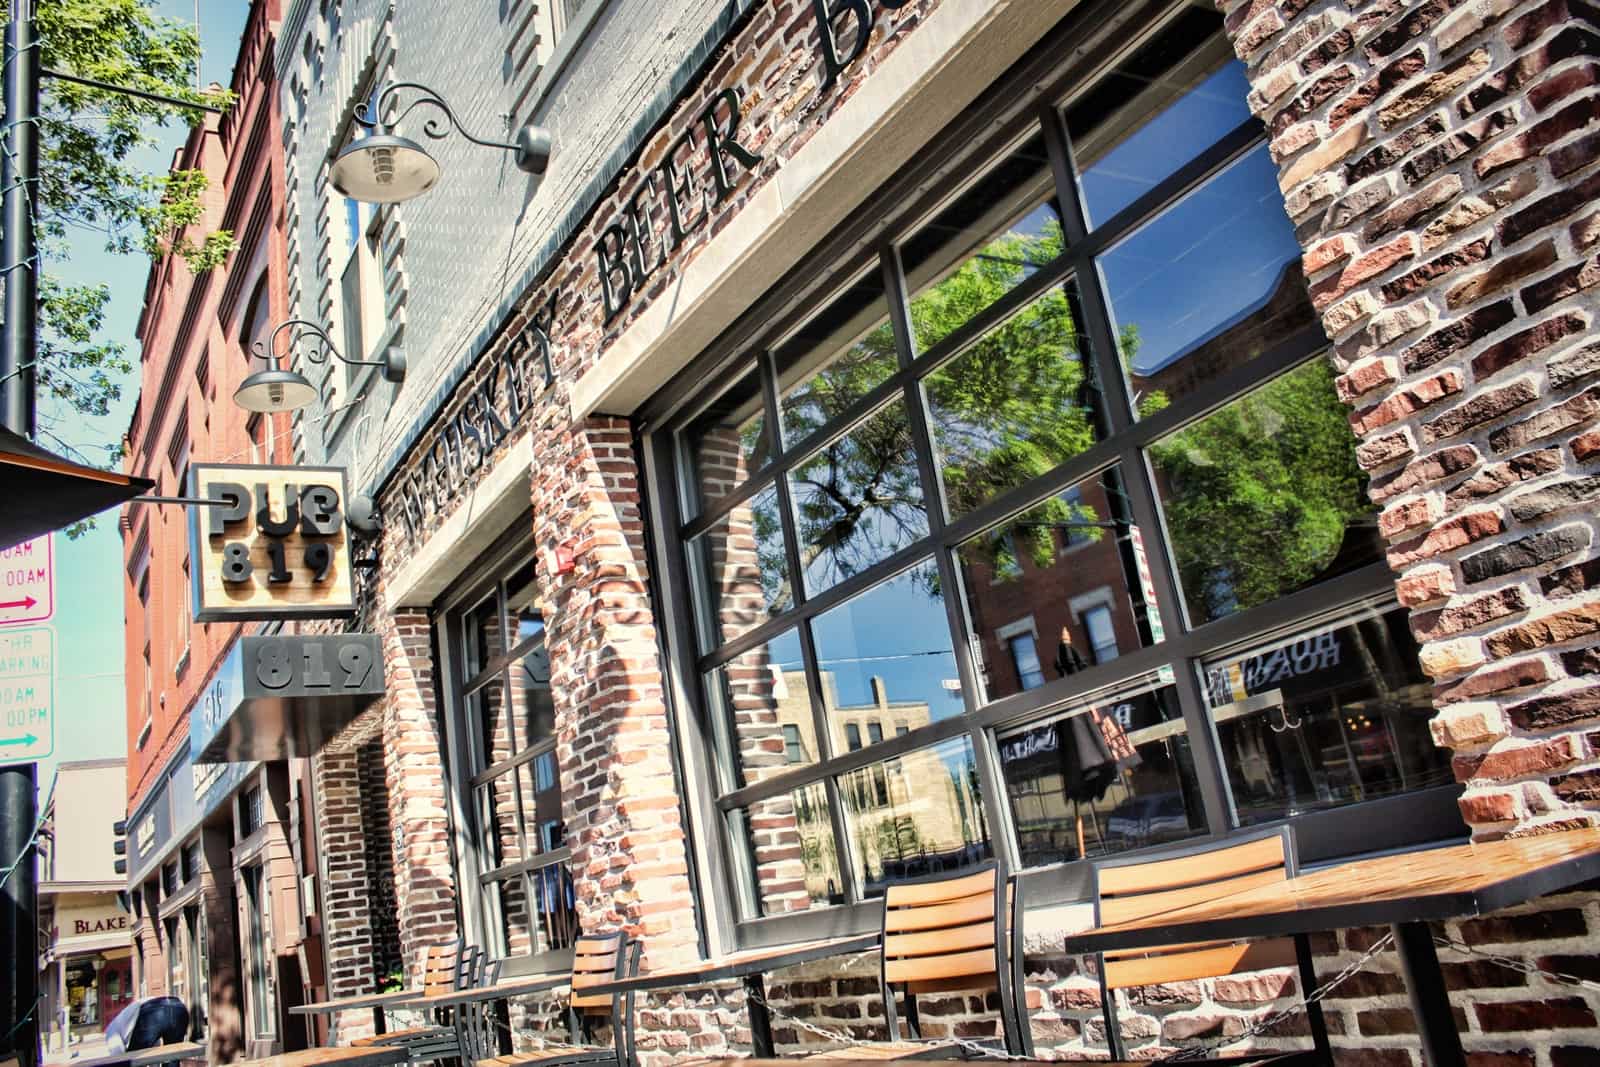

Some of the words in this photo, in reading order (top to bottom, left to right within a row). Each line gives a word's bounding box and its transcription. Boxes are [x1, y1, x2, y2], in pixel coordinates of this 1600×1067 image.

[401, 288, 559, 545] WHISKEY
[593, 88, 764, 328] BEER
[208, 482, 343, 538] PUB
[221, 542, 336, 584] 819
[256, 642, 374, 689] 819
